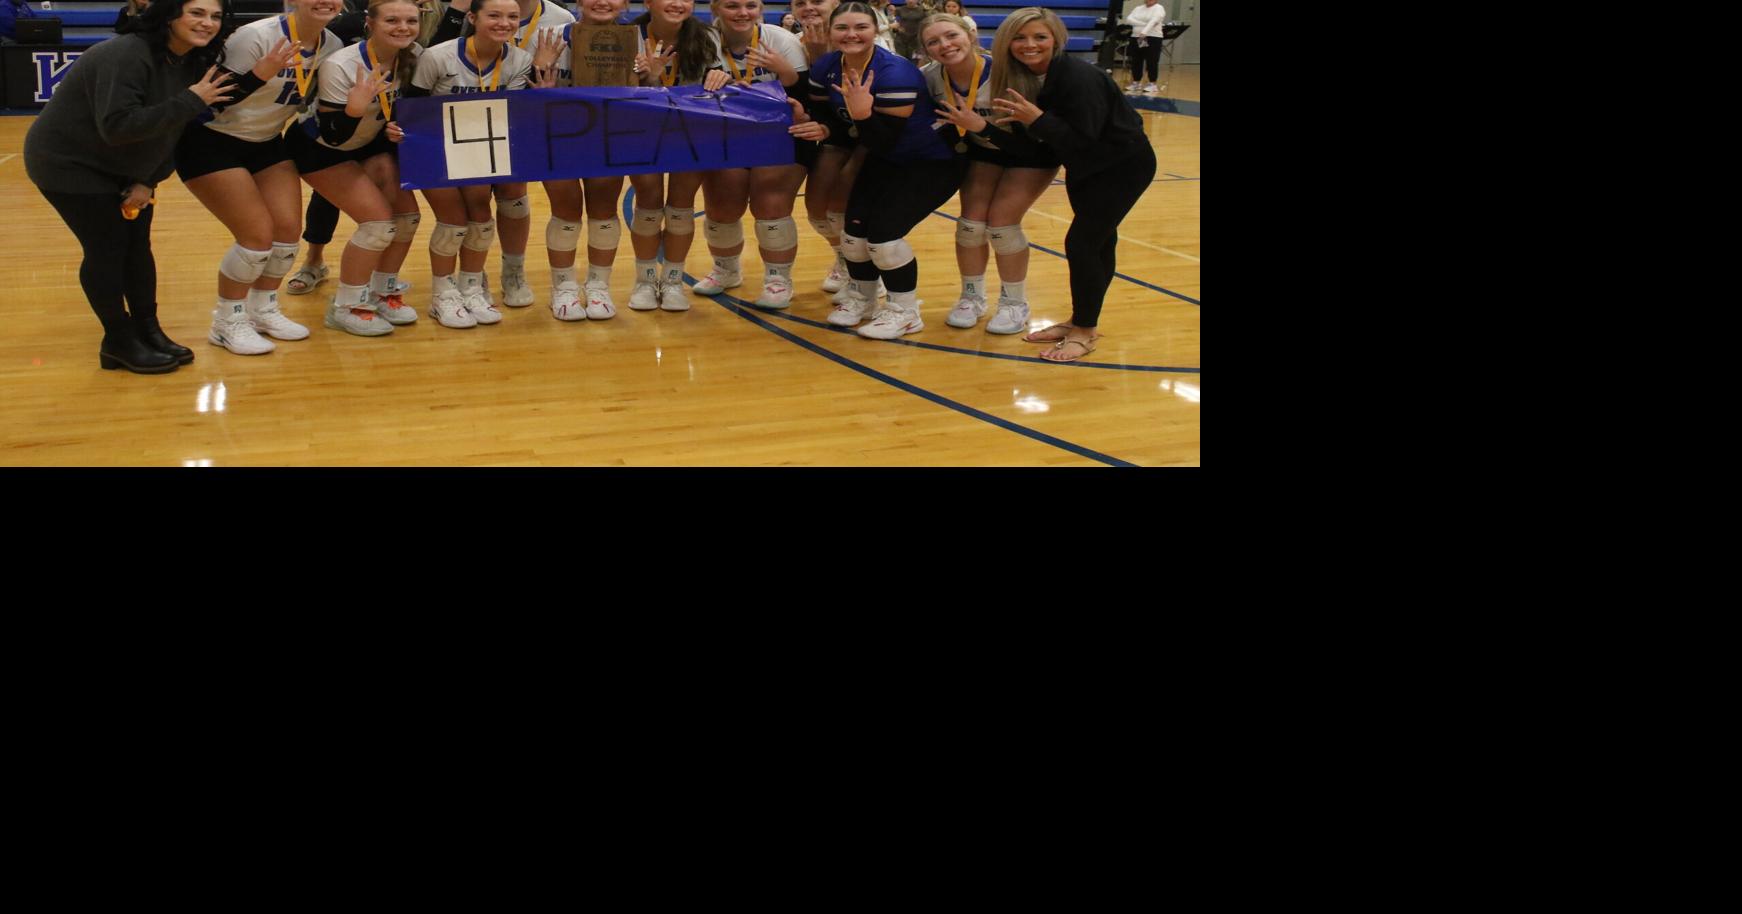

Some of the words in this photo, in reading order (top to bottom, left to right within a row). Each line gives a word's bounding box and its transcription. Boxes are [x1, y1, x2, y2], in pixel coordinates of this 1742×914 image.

[32, 52, 84, 102] K
[449, 105, 506, 174] 4
[544, 92, 740, 172] PEAT
